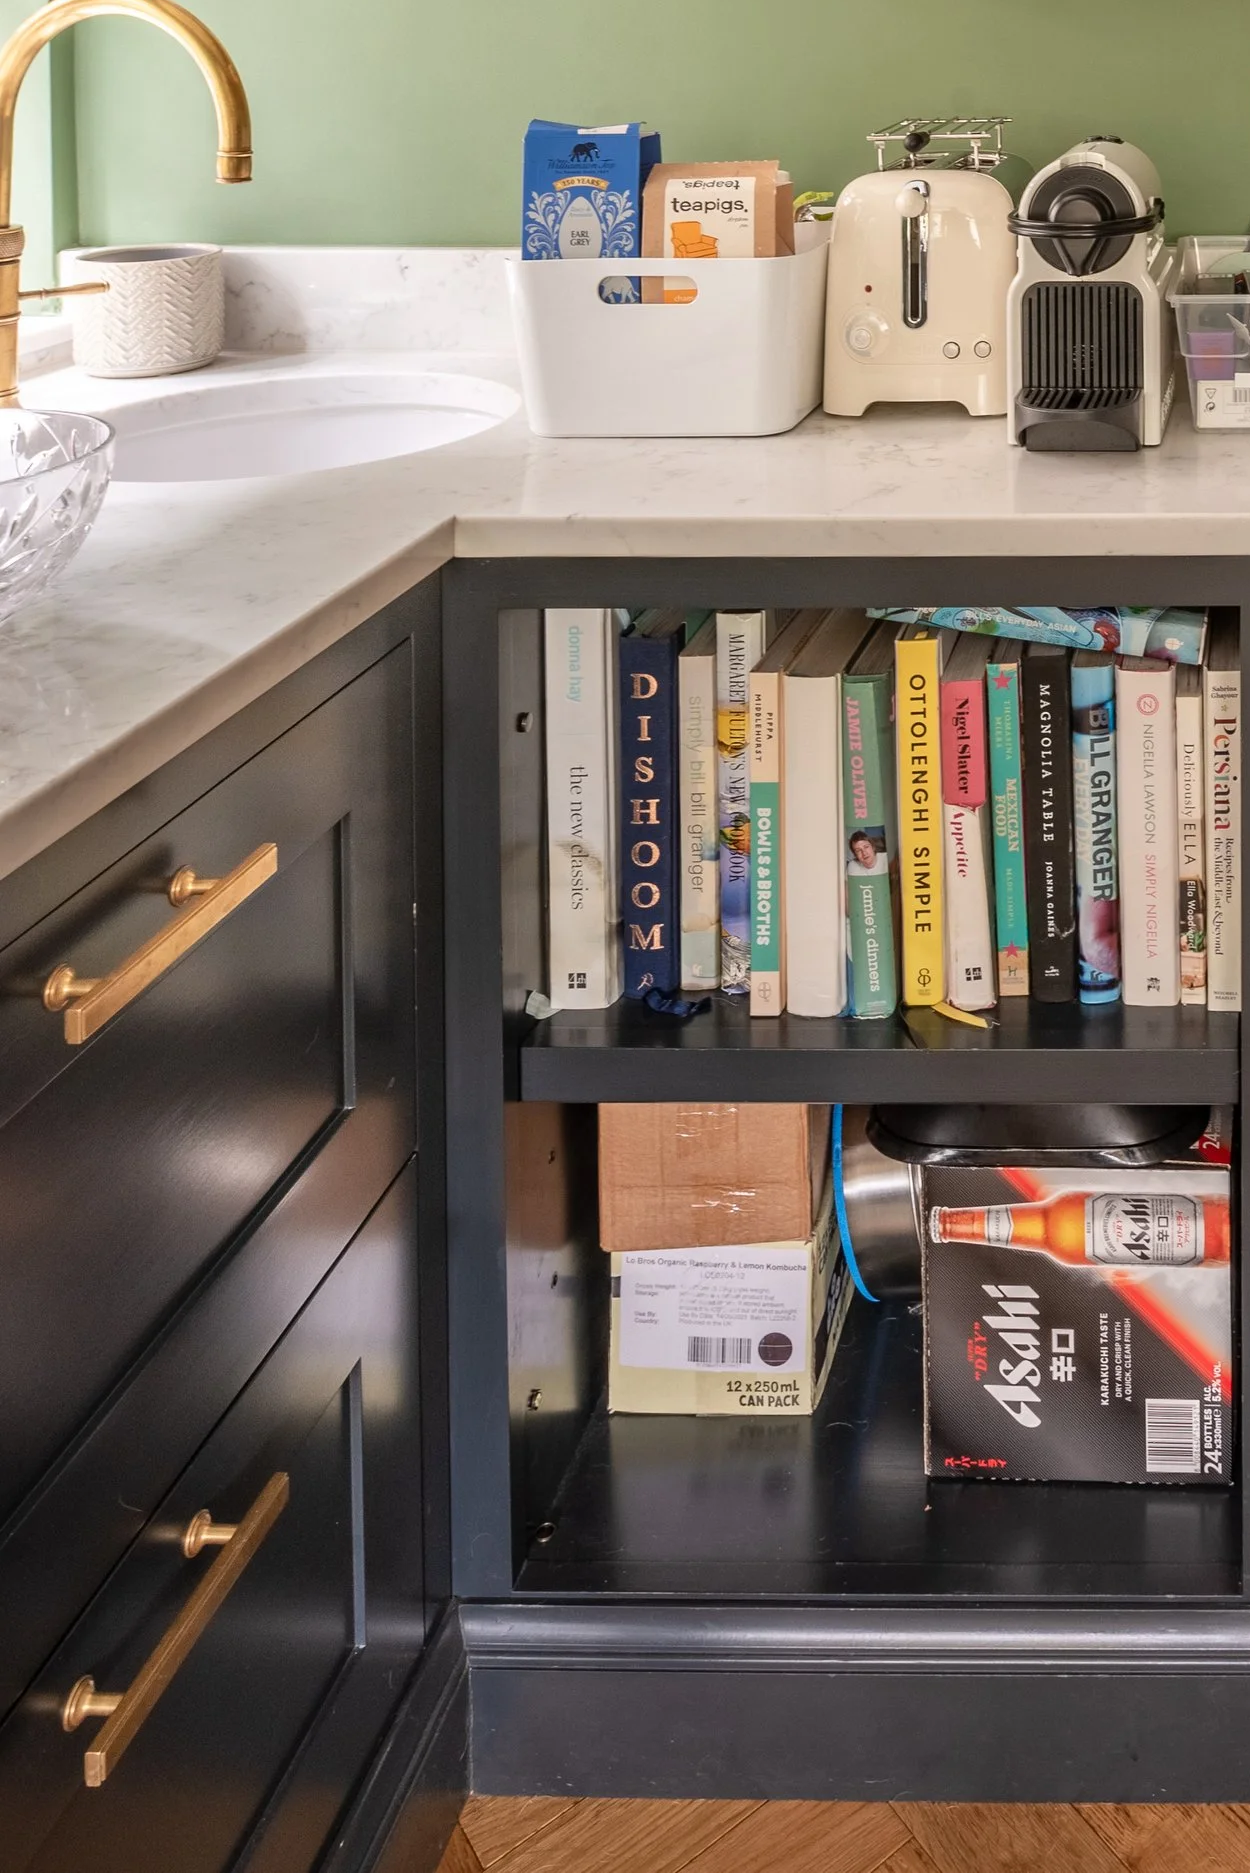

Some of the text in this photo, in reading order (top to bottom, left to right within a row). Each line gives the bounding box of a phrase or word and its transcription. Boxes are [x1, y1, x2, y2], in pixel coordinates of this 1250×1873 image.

[576, 178, 600, 187] YEARS
[670, 197, 748, 214] teapigs.
[570, 238, 590, 246] GREY
[997, 615, 1077, 633] EVERYDAY ASIAN
[566, 625, 583, 704] donna hay
[728, 633, 746, 882] MARGARET FULTON'S NEW COOKBOOK
[766, 712, 774, 741] PIPPA
[846, 696, 868, 820] JAMIE OLIVER
[953, 698, 972, 794] Nigel Slater
[684, 695, 706, 894] simply bill bill granger
[1039, 684, 1054, 842] MAGNOLIA TABLE
[1213, 716, 1238, 831] Persiana
[570, 766, 590, 910] the new classics
[629, 673, 664, 950] DISHOOM
[909, 674, 932, 933] OTTOLENGHI SIMPLE
[994, 795, 1006, 837] FOOD
[1005, 778, 1019, 852] MEXICAN
[1088, 709, 1115, 902] BILL GRANGER
[1183, 744, 1197, 865] Deliciously ELLA
[756, 807, 773, 946] BOWLS & BROTHS
[951, 811, 969, 878] Appetite
[1142, 724, 1158, 959] NIGELLA LAWSON SIMPLY NIGELLA
[1214, 837, 1223, 853] the
[1214, 854, 1223, 886] Middle
[1225, 837, 1235, 903] Recipes from
[1045, 861, 1055, 938] JOANNA GAINES
[1187, 880, 1197, 950] Ella Woodward
[859, 884, 881, 992] jamie's dinners
[1202, 1133, 1221, 1149] 24
[1121, 1198, 1151, 1260] Asahi
[1156, 1216, 1169, 1242] 辛口
[657, 1258, 687, 1268] Organic
[738, 1262, 764, 1270] Lemon
[766, 1263, 807, 1271] Kombucha
[726, 1380, 742, 1392] 12
[753, 1379, 800, 1393] 250mL
[981, 1284, 1042, 1428] Asahi
[1050, 1328, 1076, 1382] 辛口
[1100, 1312, 1109, 1406] KARAKUCHI TASTE
[1124, 1369, 1132, 1394] QUICK,
[1212, 1361, 1221, 1402] 5.2% VOL.
[738, 1394, 800, 1408] CAN PACK
[1125, 1394, 1132, 1402] A
[1204, 1385, 1222, 1474] 24 BOTTLES ALC.
